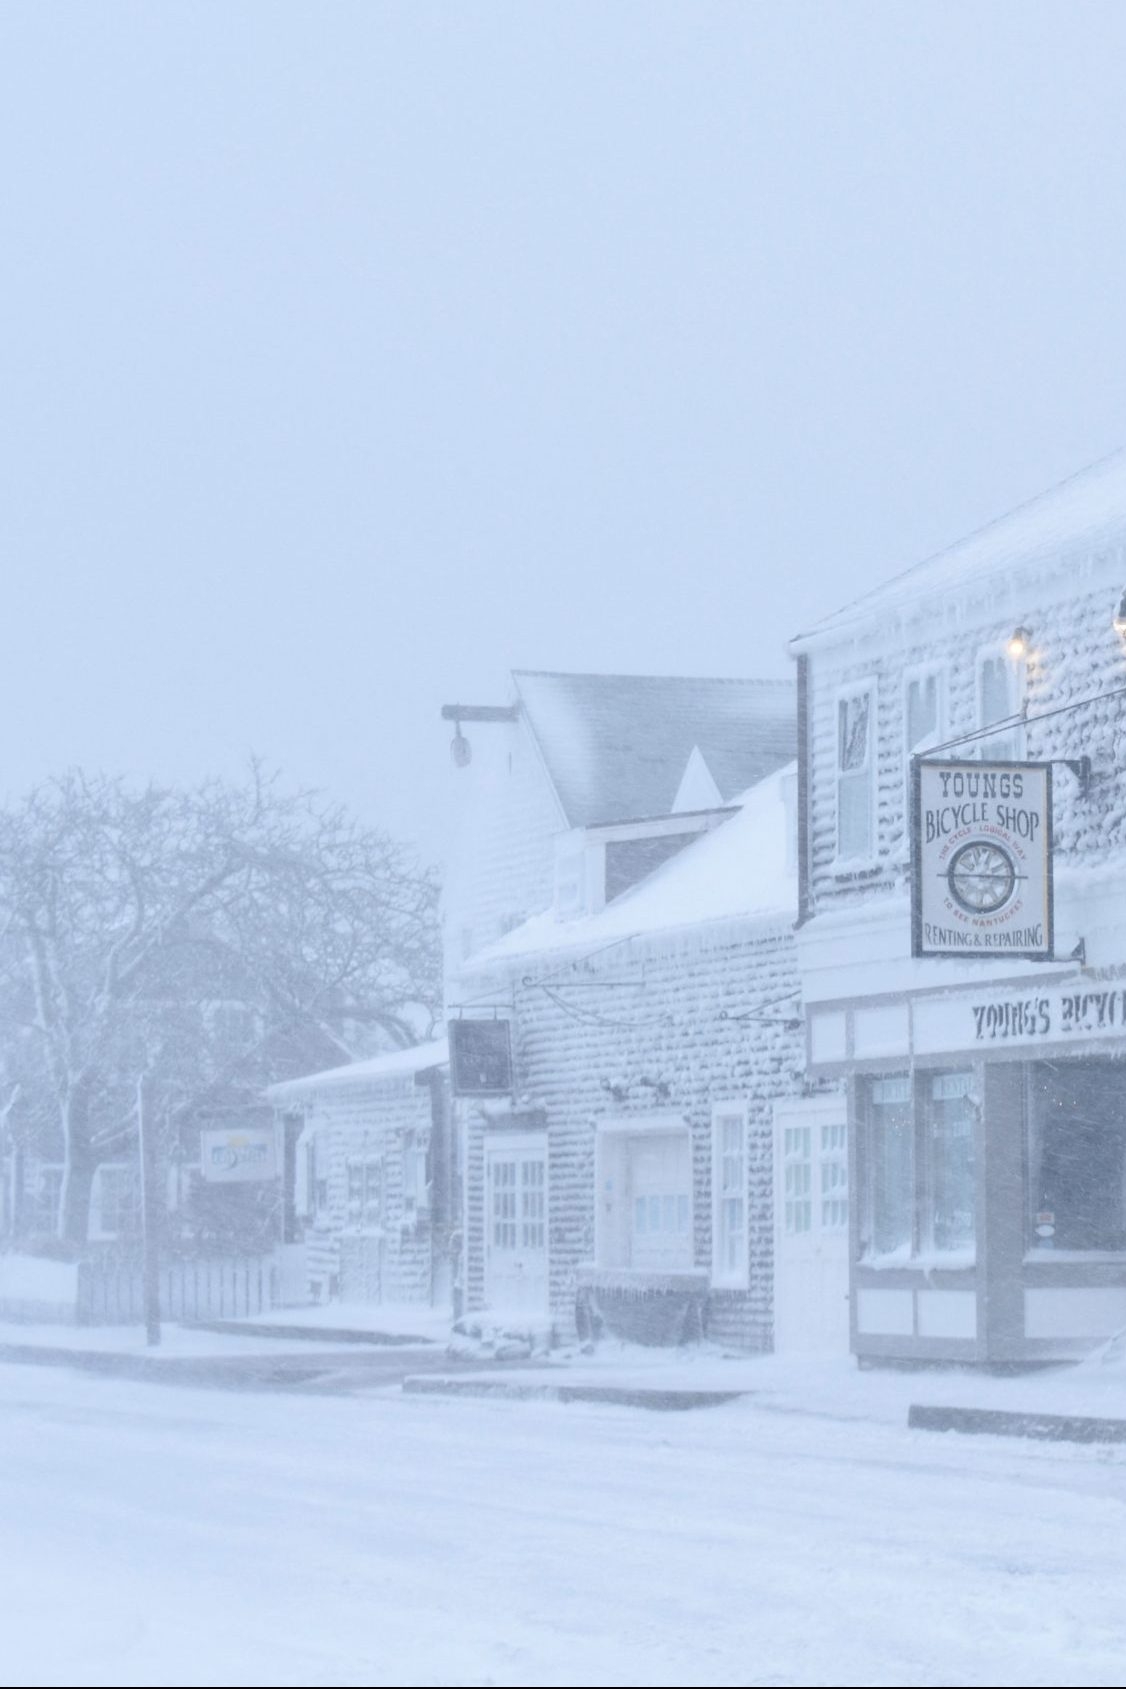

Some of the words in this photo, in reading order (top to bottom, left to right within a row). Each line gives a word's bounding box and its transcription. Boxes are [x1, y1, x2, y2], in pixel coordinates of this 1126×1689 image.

[939, 772, 1024, 798] YOUNGS
[926, 802, 988, 844] BICYCLE
[996, 804, 1040, 842] SHOP
[949, 827, 973, 845] CYCLE
[979, 824, 1012, 842] LOGICAL
[953, 909, 969, 923] SEE
[971, 899, 1024, 927] NANTUCKET
[925, 922, 973, 946] RENTING
[985, 923, 1042, 947] REPAIRING
[972, 997, 1050, 1039] YOUNG'S
